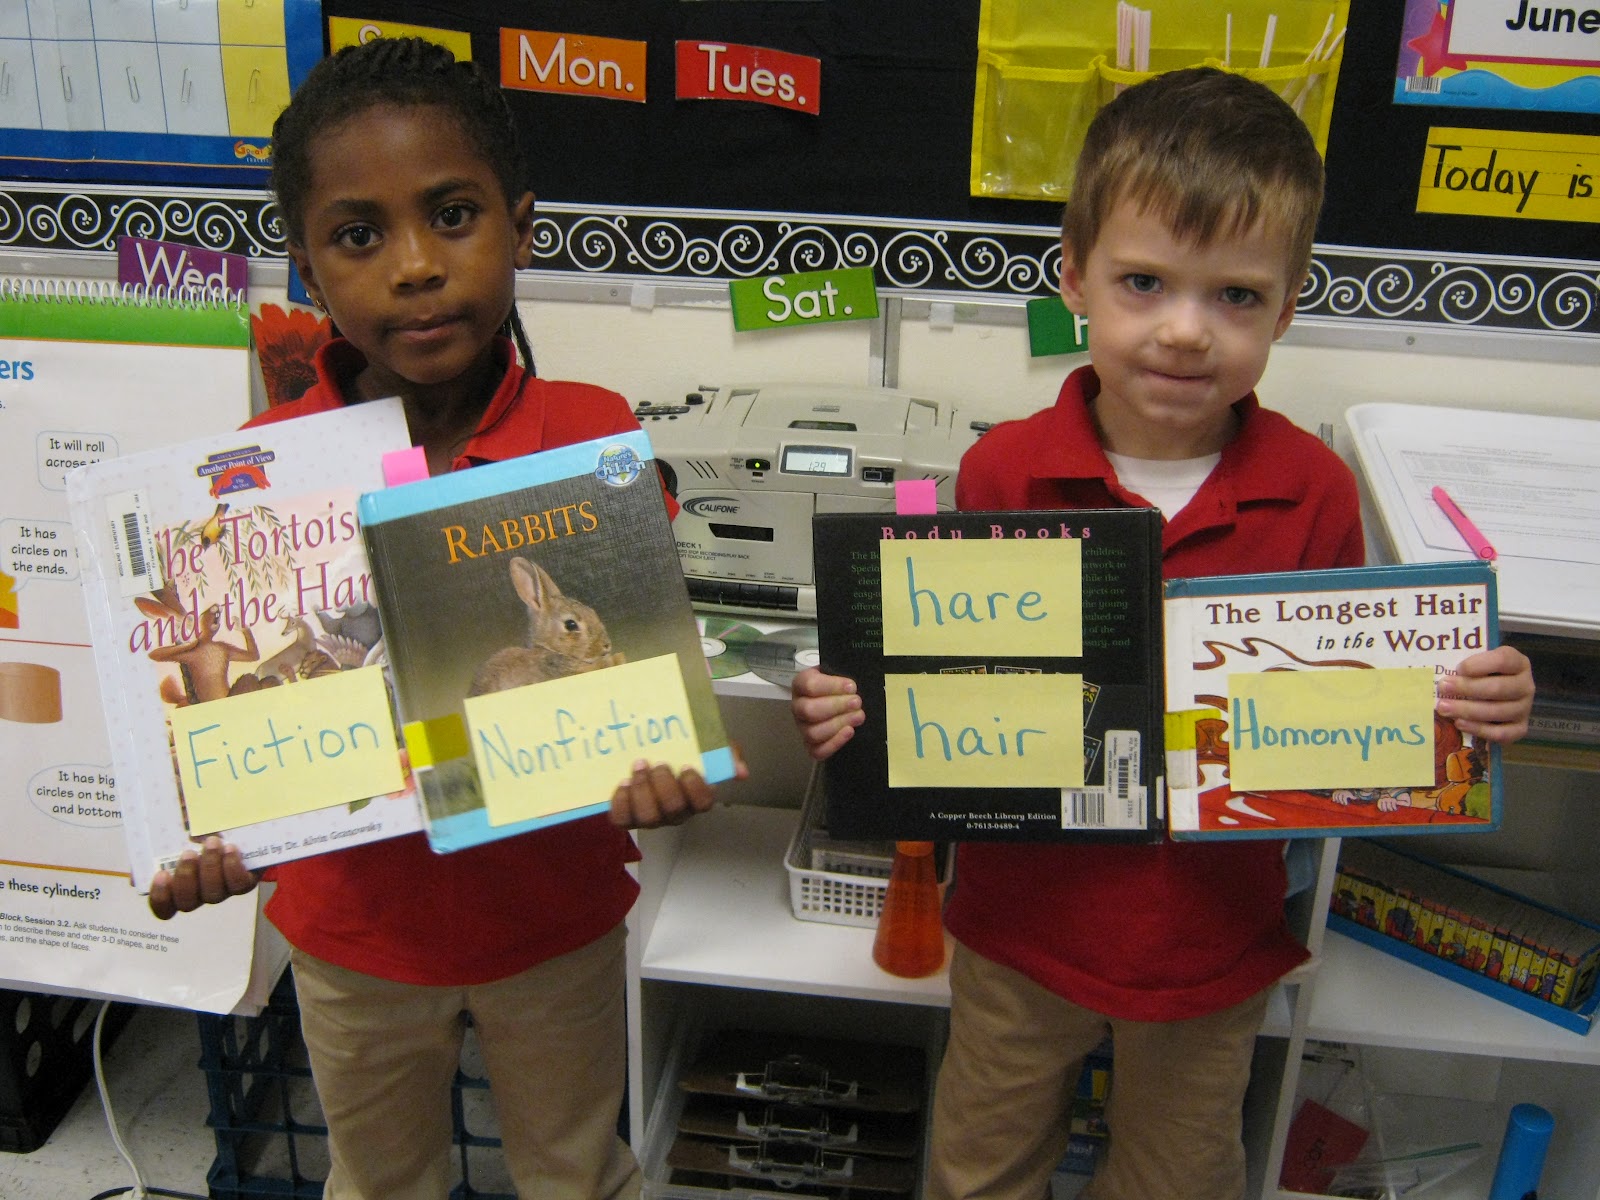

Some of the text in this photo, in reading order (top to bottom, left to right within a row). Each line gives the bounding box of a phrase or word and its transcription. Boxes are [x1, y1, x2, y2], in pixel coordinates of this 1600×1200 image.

[1506, 0, 1600, 33] June
[518, 34, 634, 92] Mon.
[698, 44, 806, 105] Tues.
[1429, 144, 1593, 213] Today is
[762, 275, 853, 322] Sat.
[49, 438, 105, 453] It will roll
[200, 463, 227, 475] Another
[228, 459, 246, 469] Point
[247, 456, 255, 465] of
[255, 454, 273, 463] View
[603, 451, 632, 462] Nature's
[699, 503, 739, 514] CALIFONE
[20, 526, 57, 540] It has
[110, 520, 120, 550] ELEMENTARY
[441, 501, 598, 565] RABBITS
[990, 523, 1091, 539] Books
[155, 501, 360, 580] he Tortois
[677, 541, 696, 549] DECK
[11, 543, 68, 557] circles on
[850, 551, 867, 560] The
[12, 561, 69, 575] the ends.
[851, 565, 880, 575] Specia
[1083, 573, 1103, 582] hile
[1104, 573, 1120, 582] the
[906, 556, 1048, 627] hare
[1082, 587, 1108, 597] ojects
[129, 560, 373, 653] and the Har
[1205, 593, 1482, 625] The Longest Hair
[855, 615, 882, 623] reade
[1083, 612, 1111, 621] sulted
[1100, 625, 1115, 634] the
[852, 640, 883, 649] inform
[1112, 638, 1131, 646] and
[1316, 626, 1482, 652] in the World
[1435, 665, 1458, 676] Dun
[907, 687, 1047, 761] hair
[1232, 697, 1426, 762] Homonyms
[1537, 719, 1582, 731] SEARCH
[478, 699, 689, 781] Nonfiction
[188, 718, 380, 789] Fiction
[58, 770, 116, 788] It has big
[36, 786, 116, 802] circles on the
[52, 803, 122, 819] and bottom
[937, 812, 966, 821] Copper
[994, 812, 1025, 821] Library
[1027, 812, 1057, 820] Edition
[271, 843, 282, 855] by
[284, 840, 299, 851] Dr.
[302, 835, 328, 847] Alvin
[8, 878, 39, 893] these
[42, 881, 101, 900] cylinders?
[24, 915, 55, 926] Session
[56, 919, 71, 928] 3.2.
[73, 920, 87, 930] Ask
[88, 922, 119, 934] students
[120, 926, 127, 935] to
[128, 928, 159, 939] consider
[159, 932, 180, 943] these
[10, 934, 23, 943] and
[25, 935, 37, 945] the
[38, 937, 61, 949] shape
[62, 940, 70, 948] of
[70, 941, 91, 952] faces.
[12, 924, 44, 936] describe
[45, 927, 65, 938] these
[67, 930, 80, 940] and
[81, 931, 100, 942] other
[101, 934, 115, 944] 3-D
[117, 937, 144, 950] shapes,
[145, 941, 159, 951] and
[160, 944, 168, 953] to
